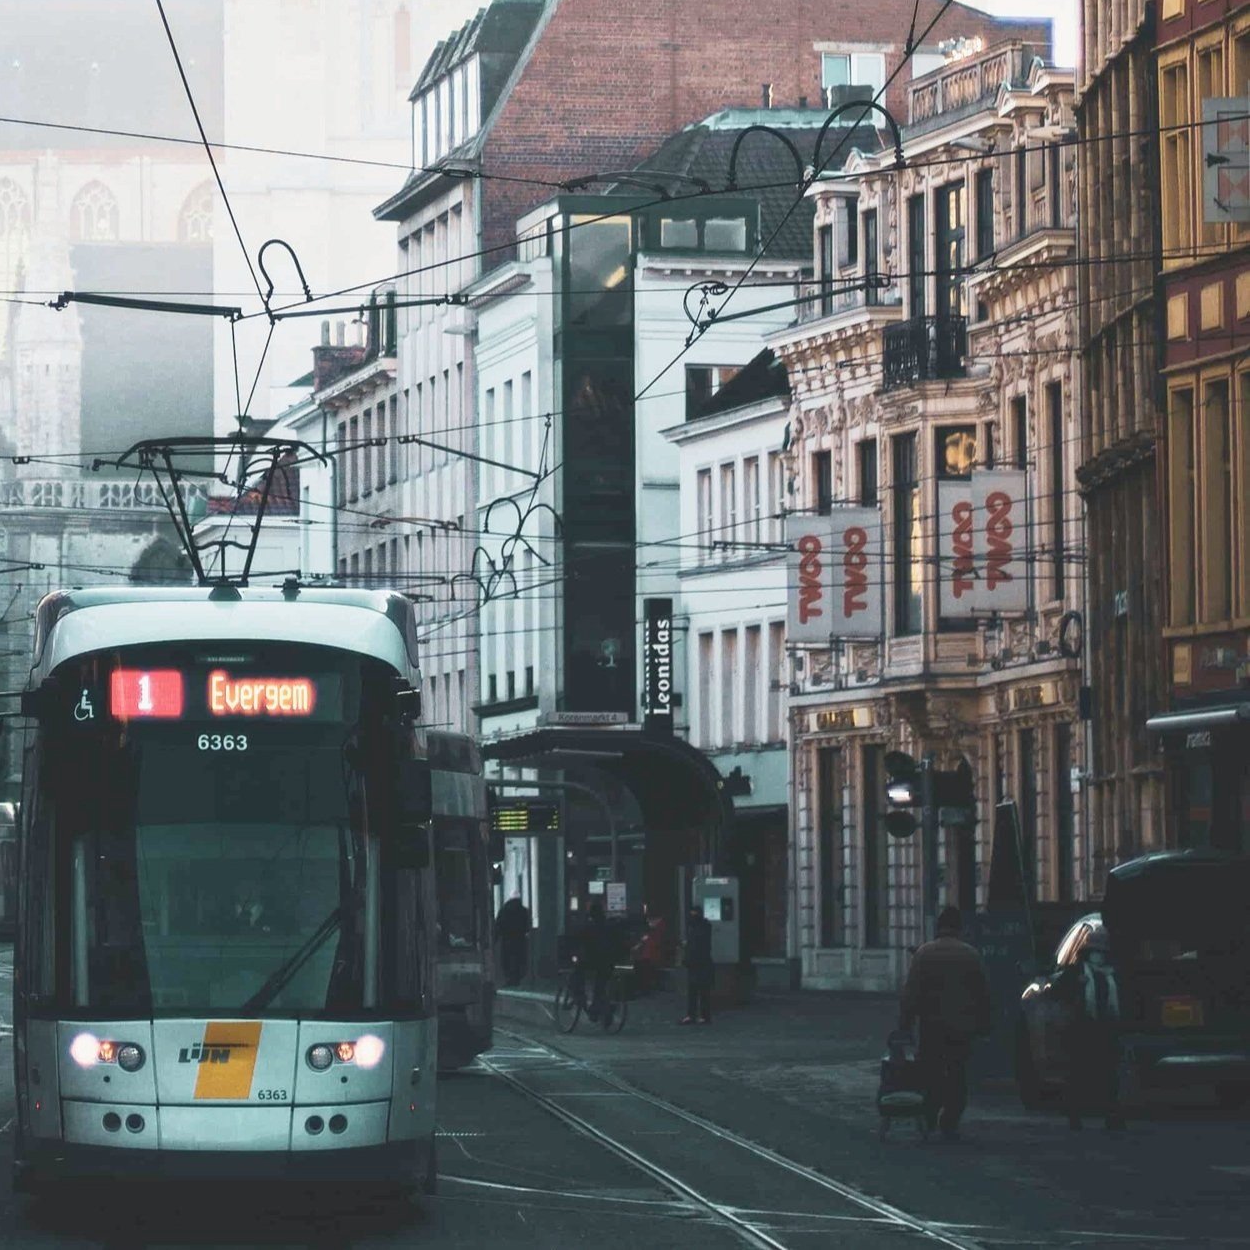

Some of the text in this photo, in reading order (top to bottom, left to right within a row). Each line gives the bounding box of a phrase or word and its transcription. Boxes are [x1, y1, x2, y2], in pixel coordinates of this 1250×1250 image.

[652, 618, 670, 715] Leonidas
[137, 674, 309, 711] 1 Evergem
[197, 734, 248, 751] 6363
[258, 1089, 287, 1101] 6363
